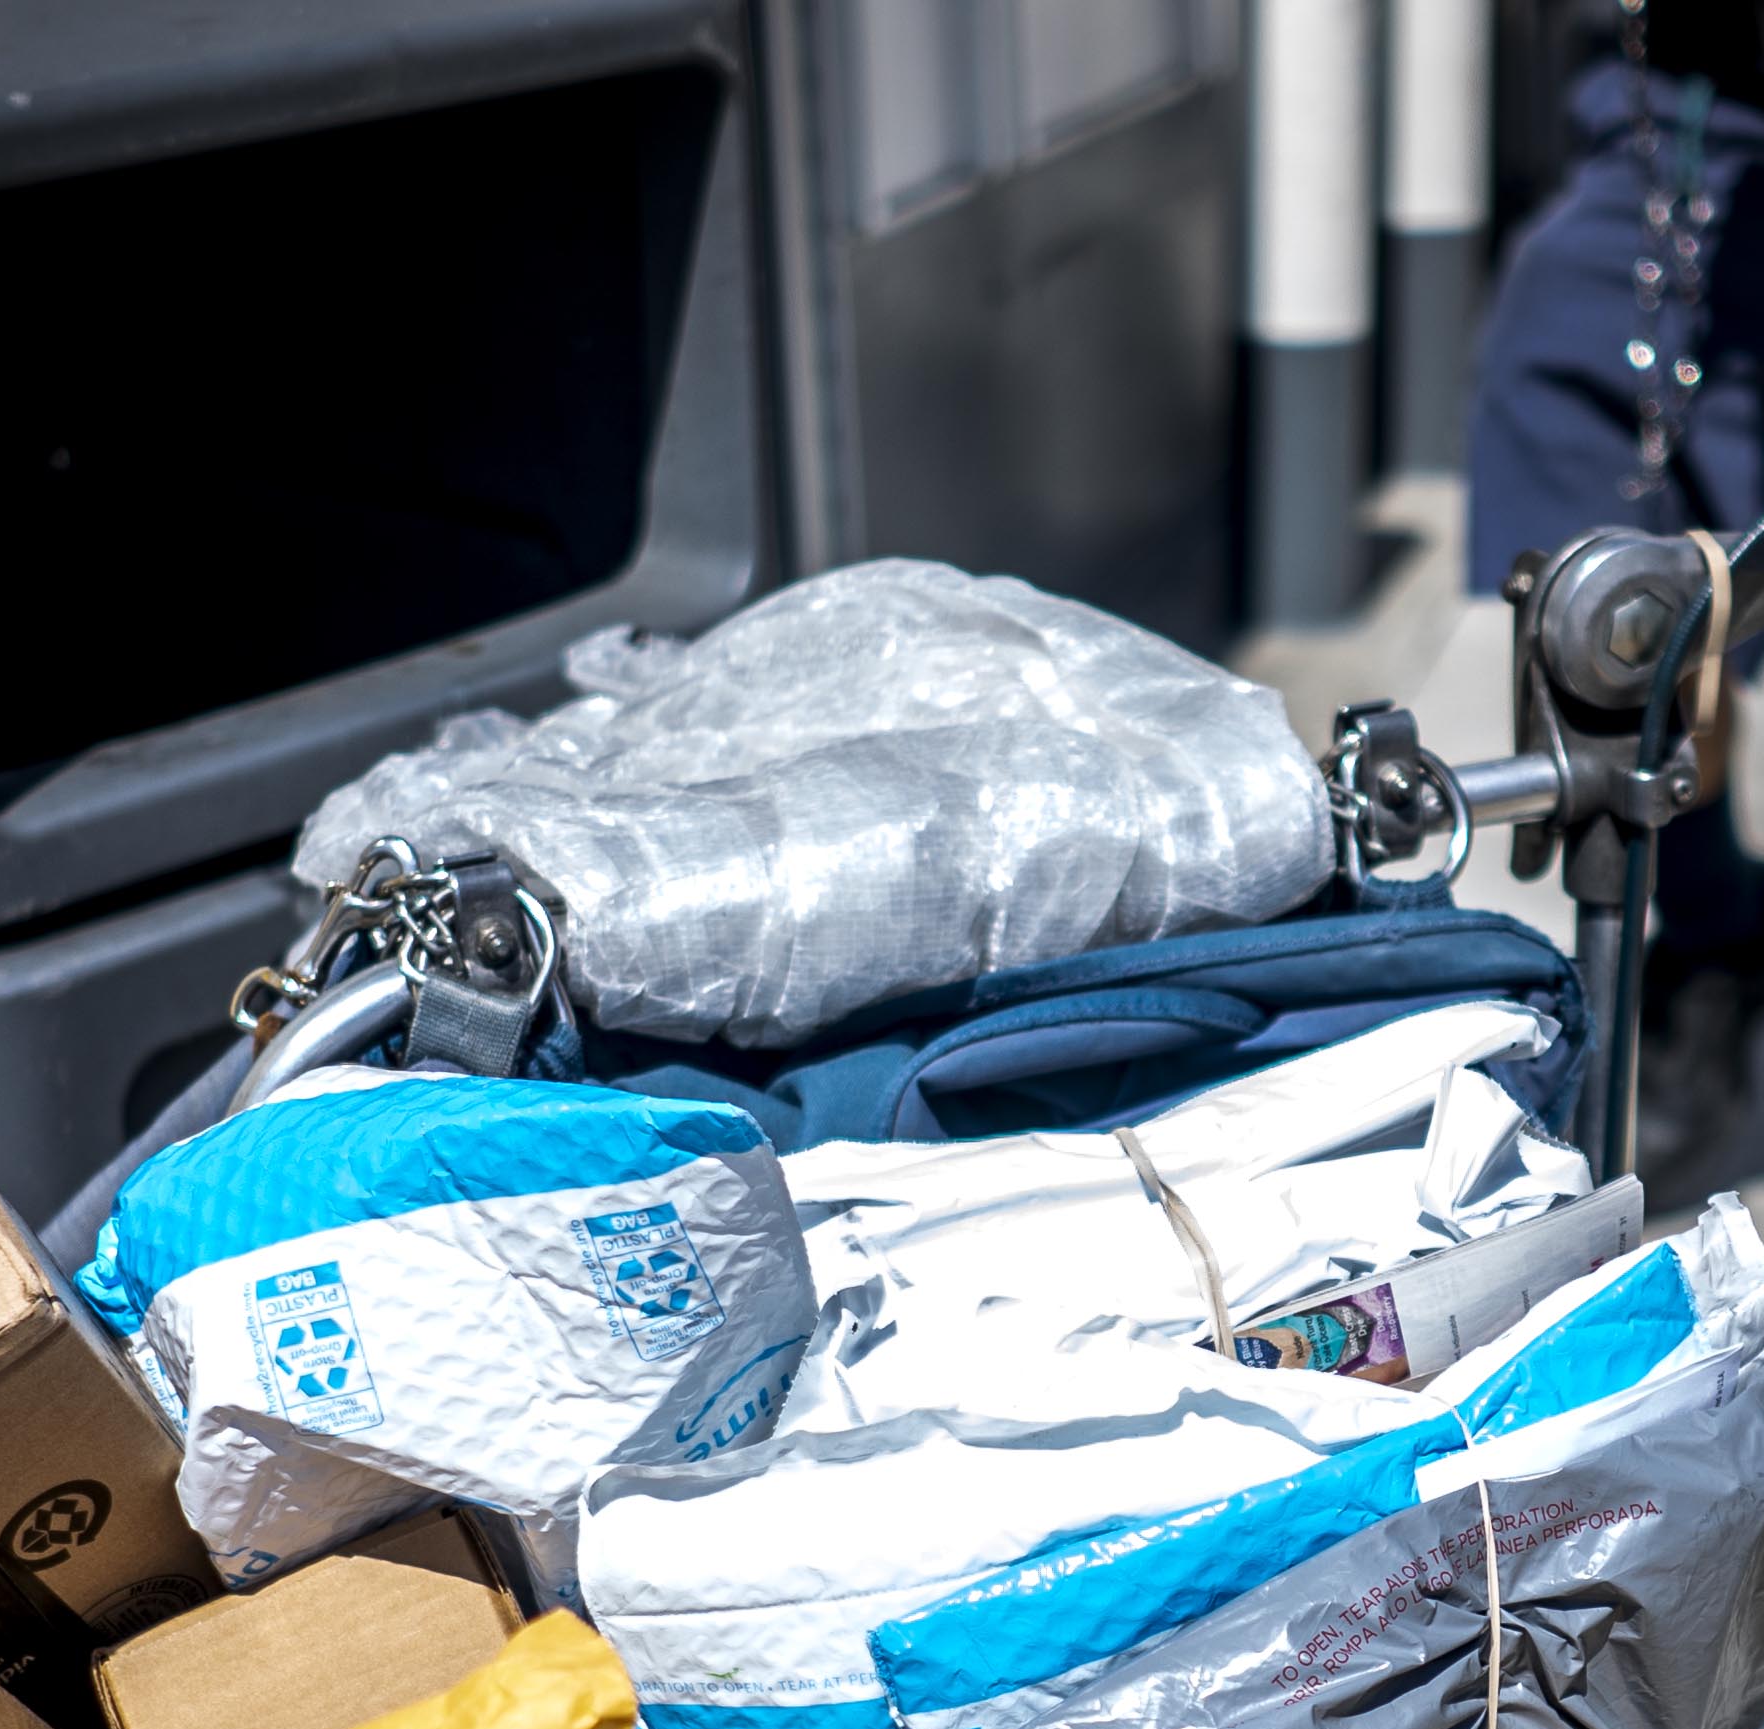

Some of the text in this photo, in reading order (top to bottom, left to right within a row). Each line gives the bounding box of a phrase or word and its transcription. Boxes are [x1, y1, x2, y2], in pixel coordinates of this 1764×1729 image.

[610, 1212, 650, 1230] BAG
[601, 1226, 677, 1251] PLASTIC
[274, 1270, 317, 1293] BAG
[630, 1268, 683, 1290] Drop-off
[644, 1282, 677, 1296] Store
[265, 1287, 340, 1317] PLASTIC
[1271, 1499, 1579, 1690] TO OPEN, TEAR ALONG THE PERORATION.
[1323, 1627, 1379, 1676] ROMPA
[1378, 1615, 1393, 1632] A
[1388, 1597, 1408, 1620] LO
[1494, 1534, 1539, 1556] INEA
[1542, 1500, 1664, 1542] PERFORADA.
[699, 1681, 720, 1693] TO
[723, 1681, 765, 1694] OPEN
[777, 1679, 817, 1692] TEAR
[824, 1676, 843, 1690] AT
